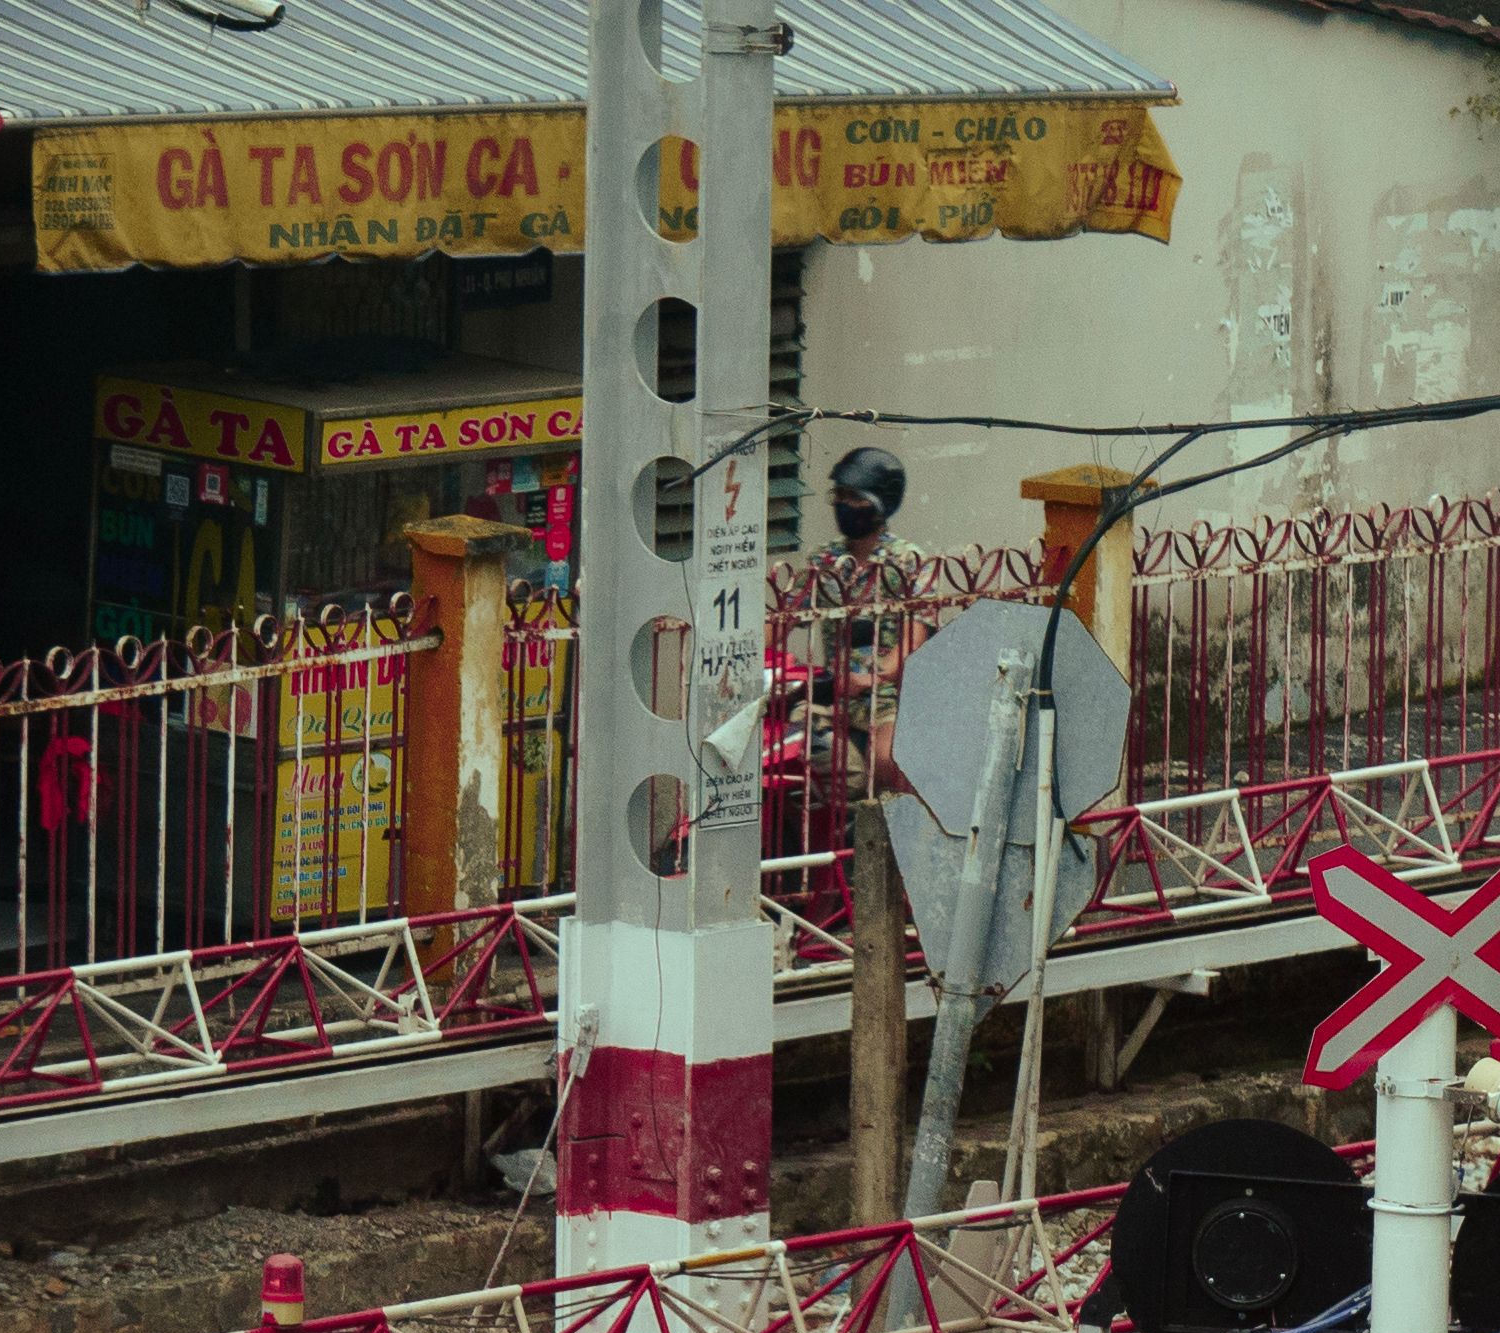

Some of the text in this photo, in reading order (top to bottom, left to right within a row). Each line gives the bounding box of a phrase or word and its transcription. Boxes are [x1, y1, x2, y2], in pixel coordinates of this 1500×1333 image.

[156, 128, 230, 210] GÀ
[249, 145, 320, 206] TA
[339, 133, 447, 203] SƠN
[466, 137, 540, 199] CA
[843, 155, 915, 188] BÚN
[269, 207, 572, 254] NHẬN ĐẶT GÀ
[104, 387, 192, 450] GÀ
[209, 409, 297, 467] TA
[327, 421, 384, 459] GÀ
[395, 422, 447, 454] TA
[458, 410, 537, 447] SƠN
[713, 586, 741, 631] 11
